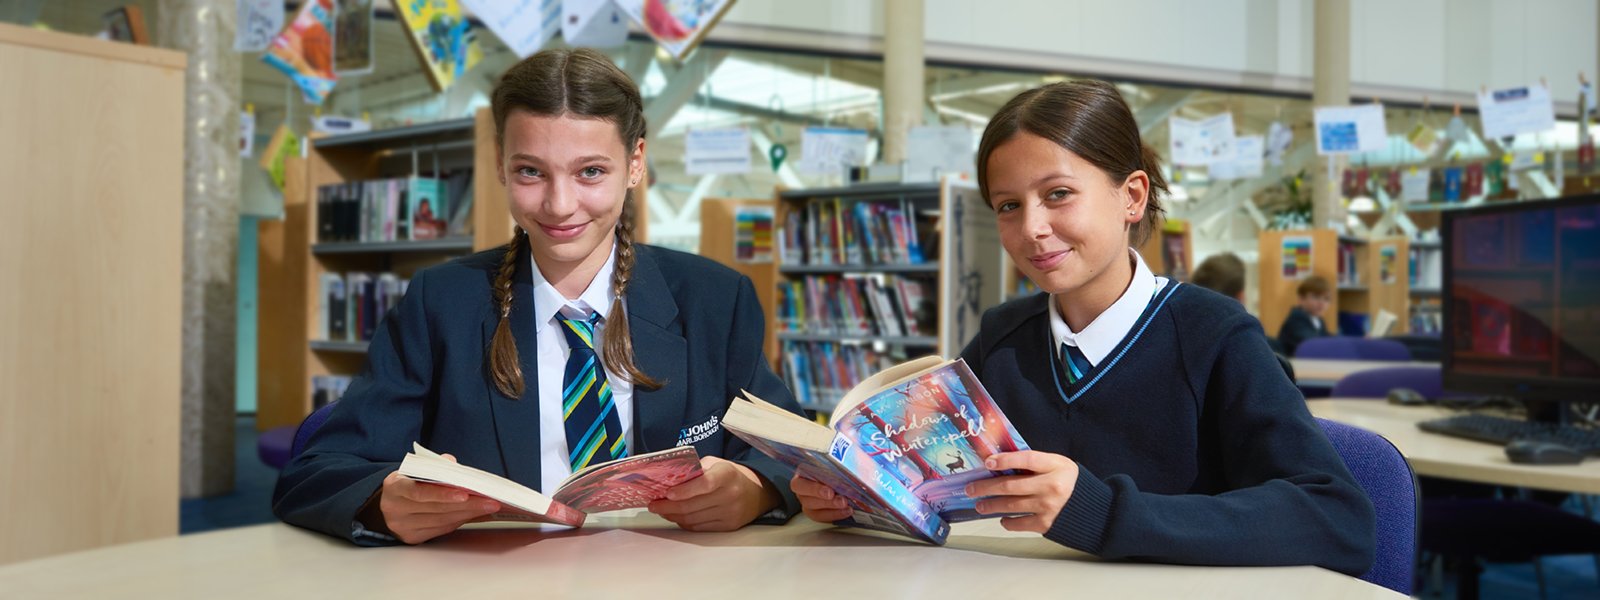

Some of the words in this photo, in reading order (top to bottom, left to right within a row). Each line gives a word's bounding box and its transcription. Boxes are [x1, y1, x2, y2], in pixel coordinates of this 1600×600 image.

[675, 424, 719, 447] MARLBOROUGH
[686, 415, 718, 437] JOHN'S
[871, 413, 949, 446] Shadows
[954, 404, 969, 420] of
[882, 416, 986, 462] Winterspell
